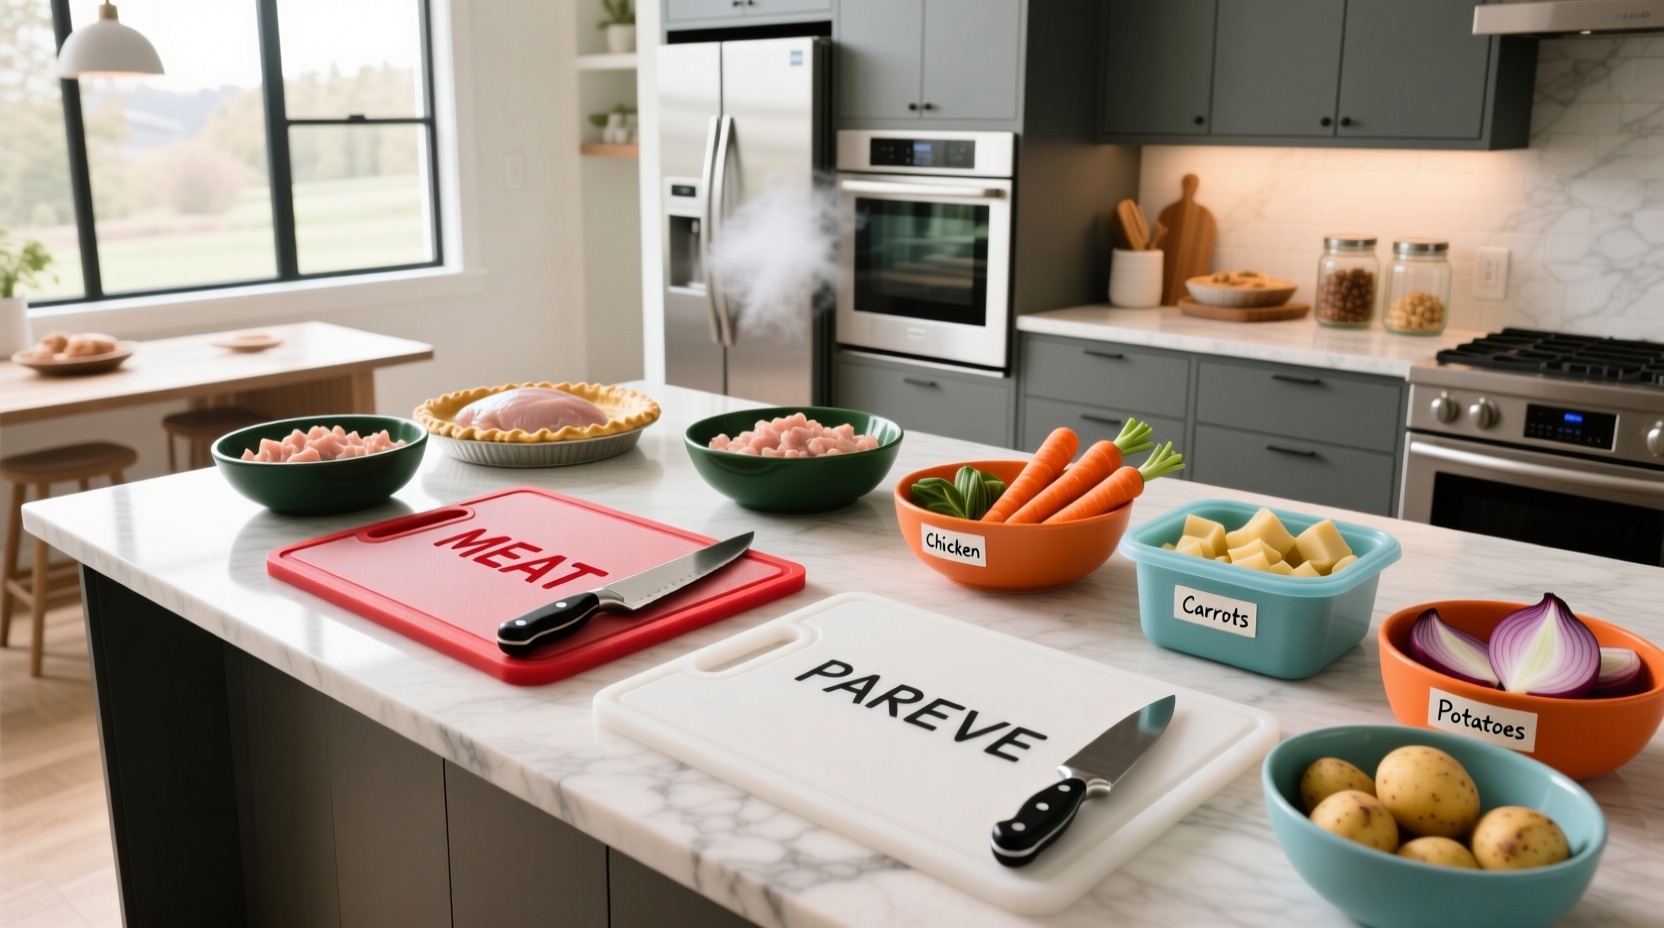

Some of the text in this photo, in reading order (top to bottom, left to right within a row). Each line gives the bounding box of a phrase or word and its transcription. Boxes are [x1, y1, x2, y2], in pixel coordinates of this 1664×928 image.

[433, 528, 609, 589] MEAT
[925, 532, 980, 559] Chicken
[1182, 595, 1249, 628] Carrots
[794, 659, 1048, 763] PAREVE
[1438, 699, 1525, 740] Potatoes
